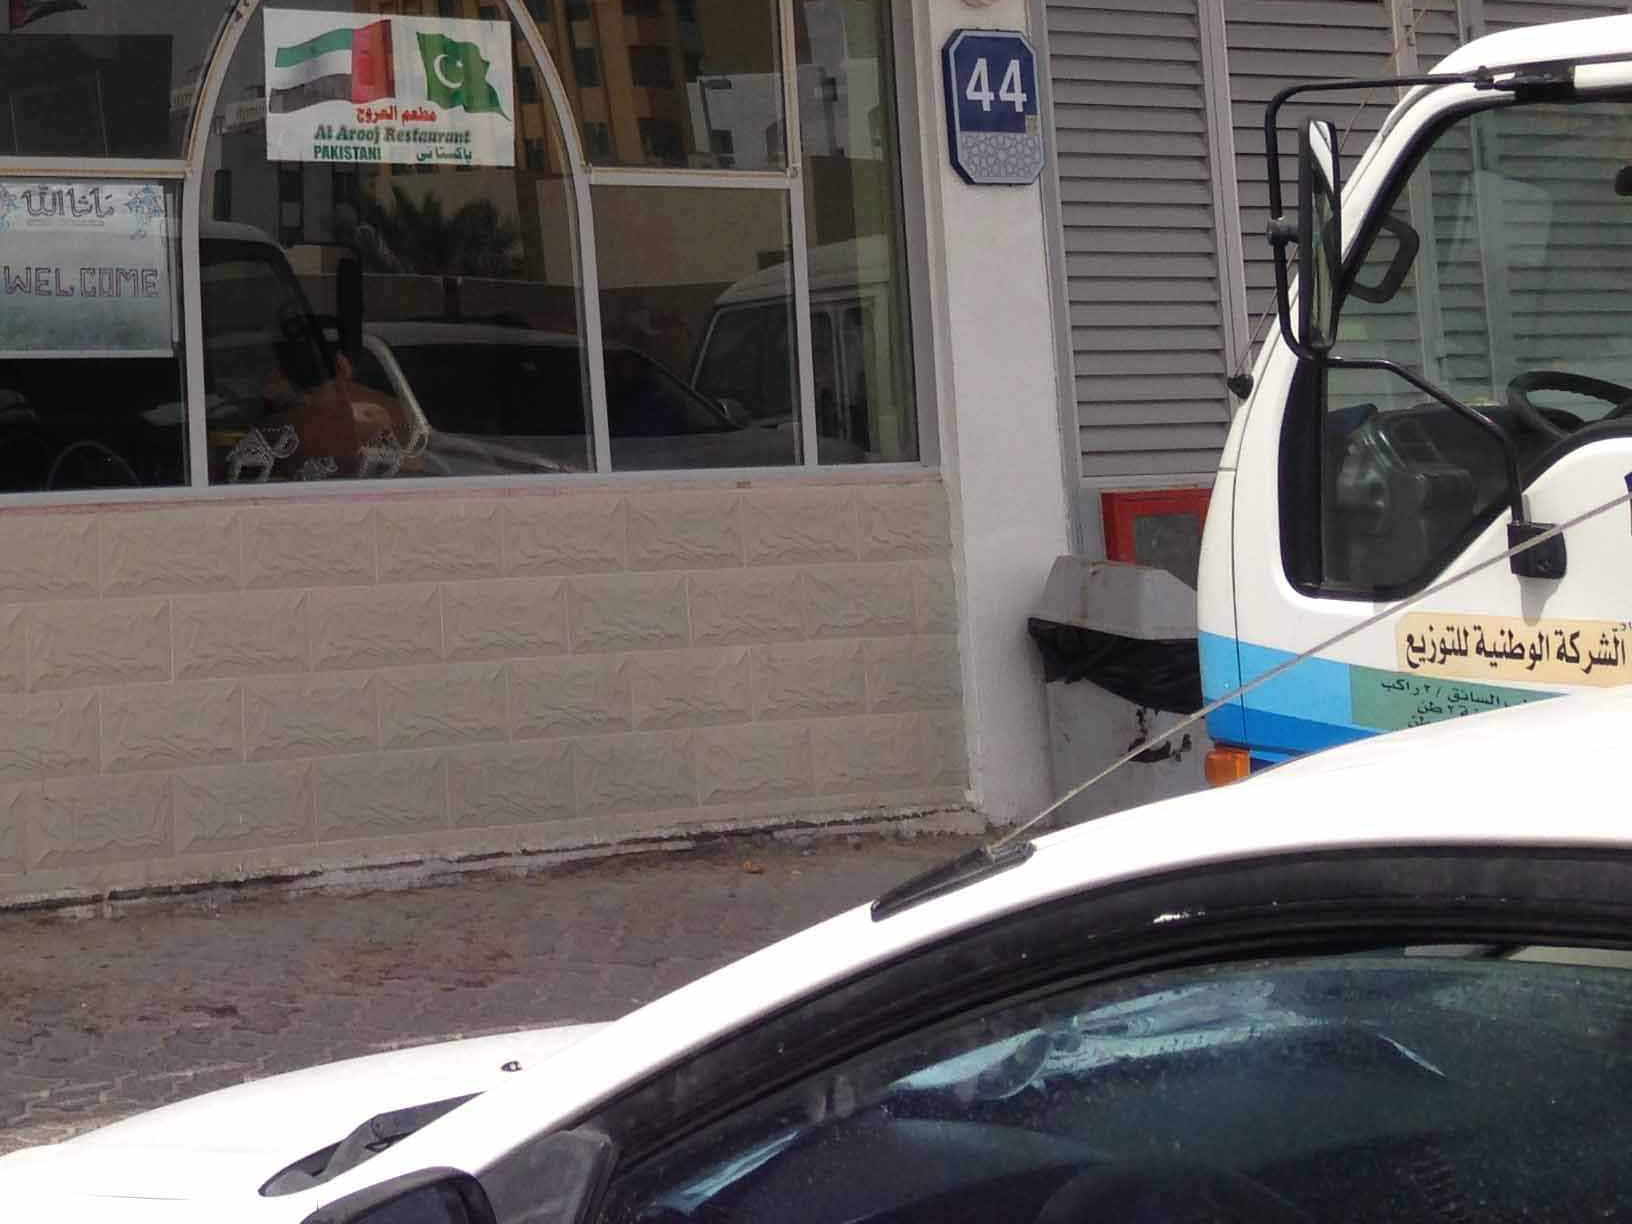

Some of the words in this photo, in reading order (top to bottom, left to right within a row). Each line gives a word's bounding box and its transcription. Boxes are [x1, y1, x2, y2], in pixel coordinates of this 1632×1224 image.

[966, 58, 1027, 112] 44
[356, 104, 397, 124] العروج
[401, 106, 438, 127] مطعم
[314, 123, 332, 141] Al
[335, 125, 380, 145] Arooj
[383, 127, 471, 144] Restaurant
[313, 145, 382, 161] PAKISTANI
[3, 264, 160, 298] WELCOME
[1406, 625, 1470, 669] للتوزيع
[1475, 625, 1550, 671] الوطنية
[1556, 628, 1626, 674] الشركة
